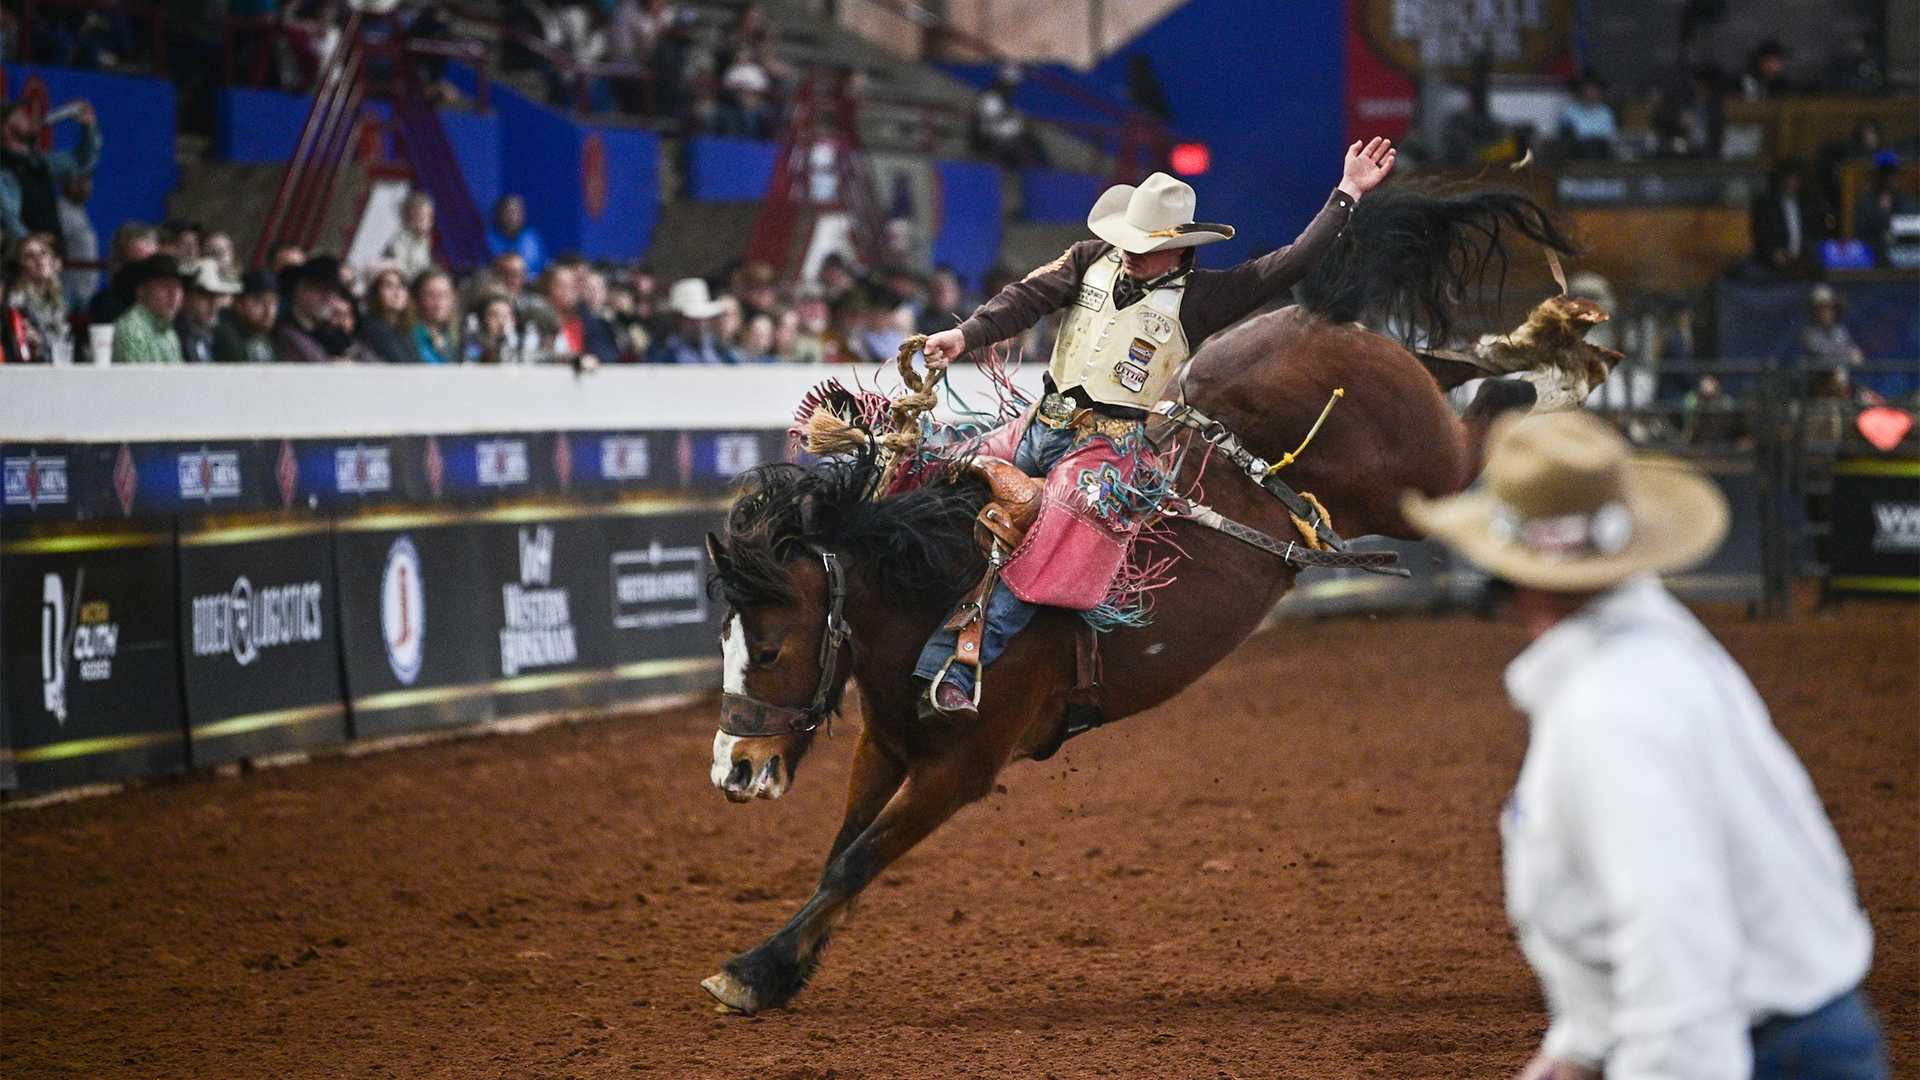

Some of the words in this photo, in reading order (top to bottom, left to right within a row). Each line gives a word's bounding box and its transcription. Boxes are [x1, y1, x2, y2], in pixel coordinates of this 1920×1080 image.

[252, 580, 322, 650] LOGISTICS
[502, 582, 570, 629] WESTERN
[499, 626, 578, 676] HORSEMAN
